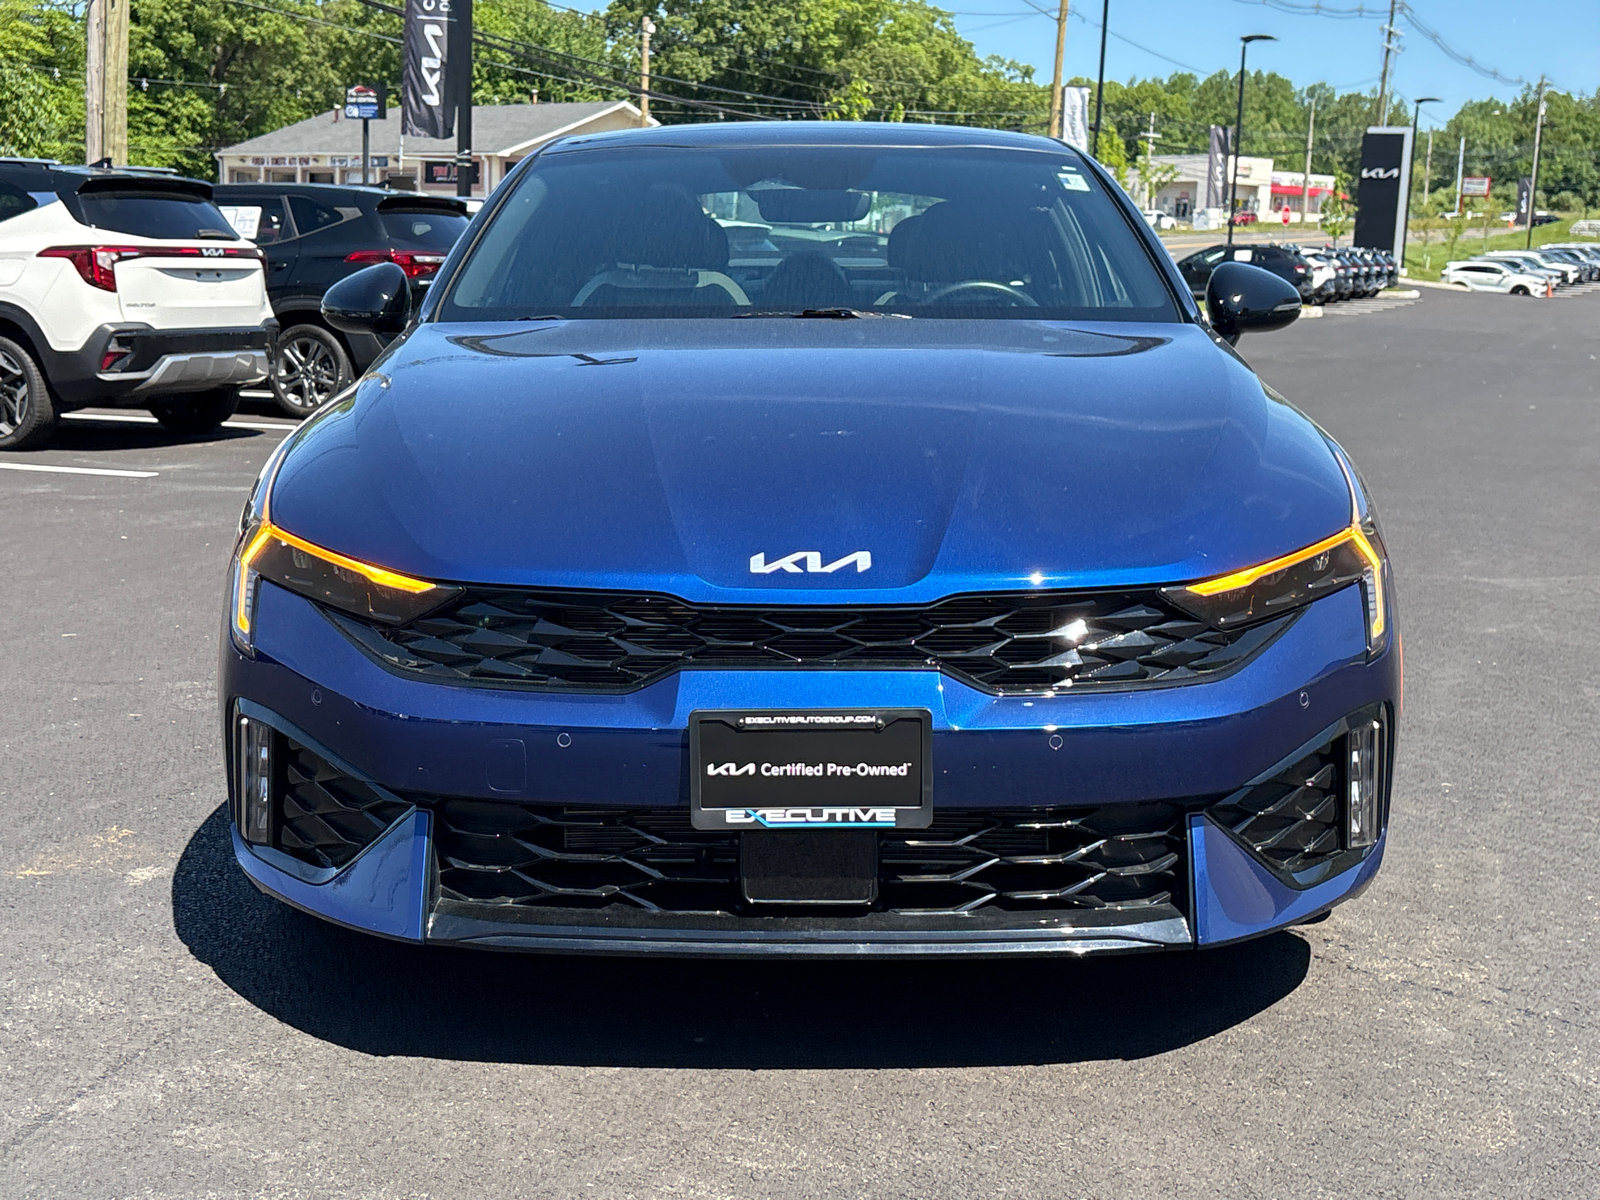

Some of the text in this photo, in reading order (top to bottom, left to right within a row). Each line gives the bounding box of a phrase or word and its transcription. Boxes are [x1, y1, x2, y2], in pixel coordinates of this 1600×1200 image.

[421, 24, 443, 106] KIA
[1361, 167, 1399, 179] KIA
[201, 248, 224, 257] KIA
[749, 550, 872, 574] KIA
[744, 715, 876, 725] EXECUTIVEAUTOGROUP.COM
[707, 762, 756, 777] KIA
[760, 762, 824, 777] Certified
[725, 808, 896, 826] EXECUTIVE
